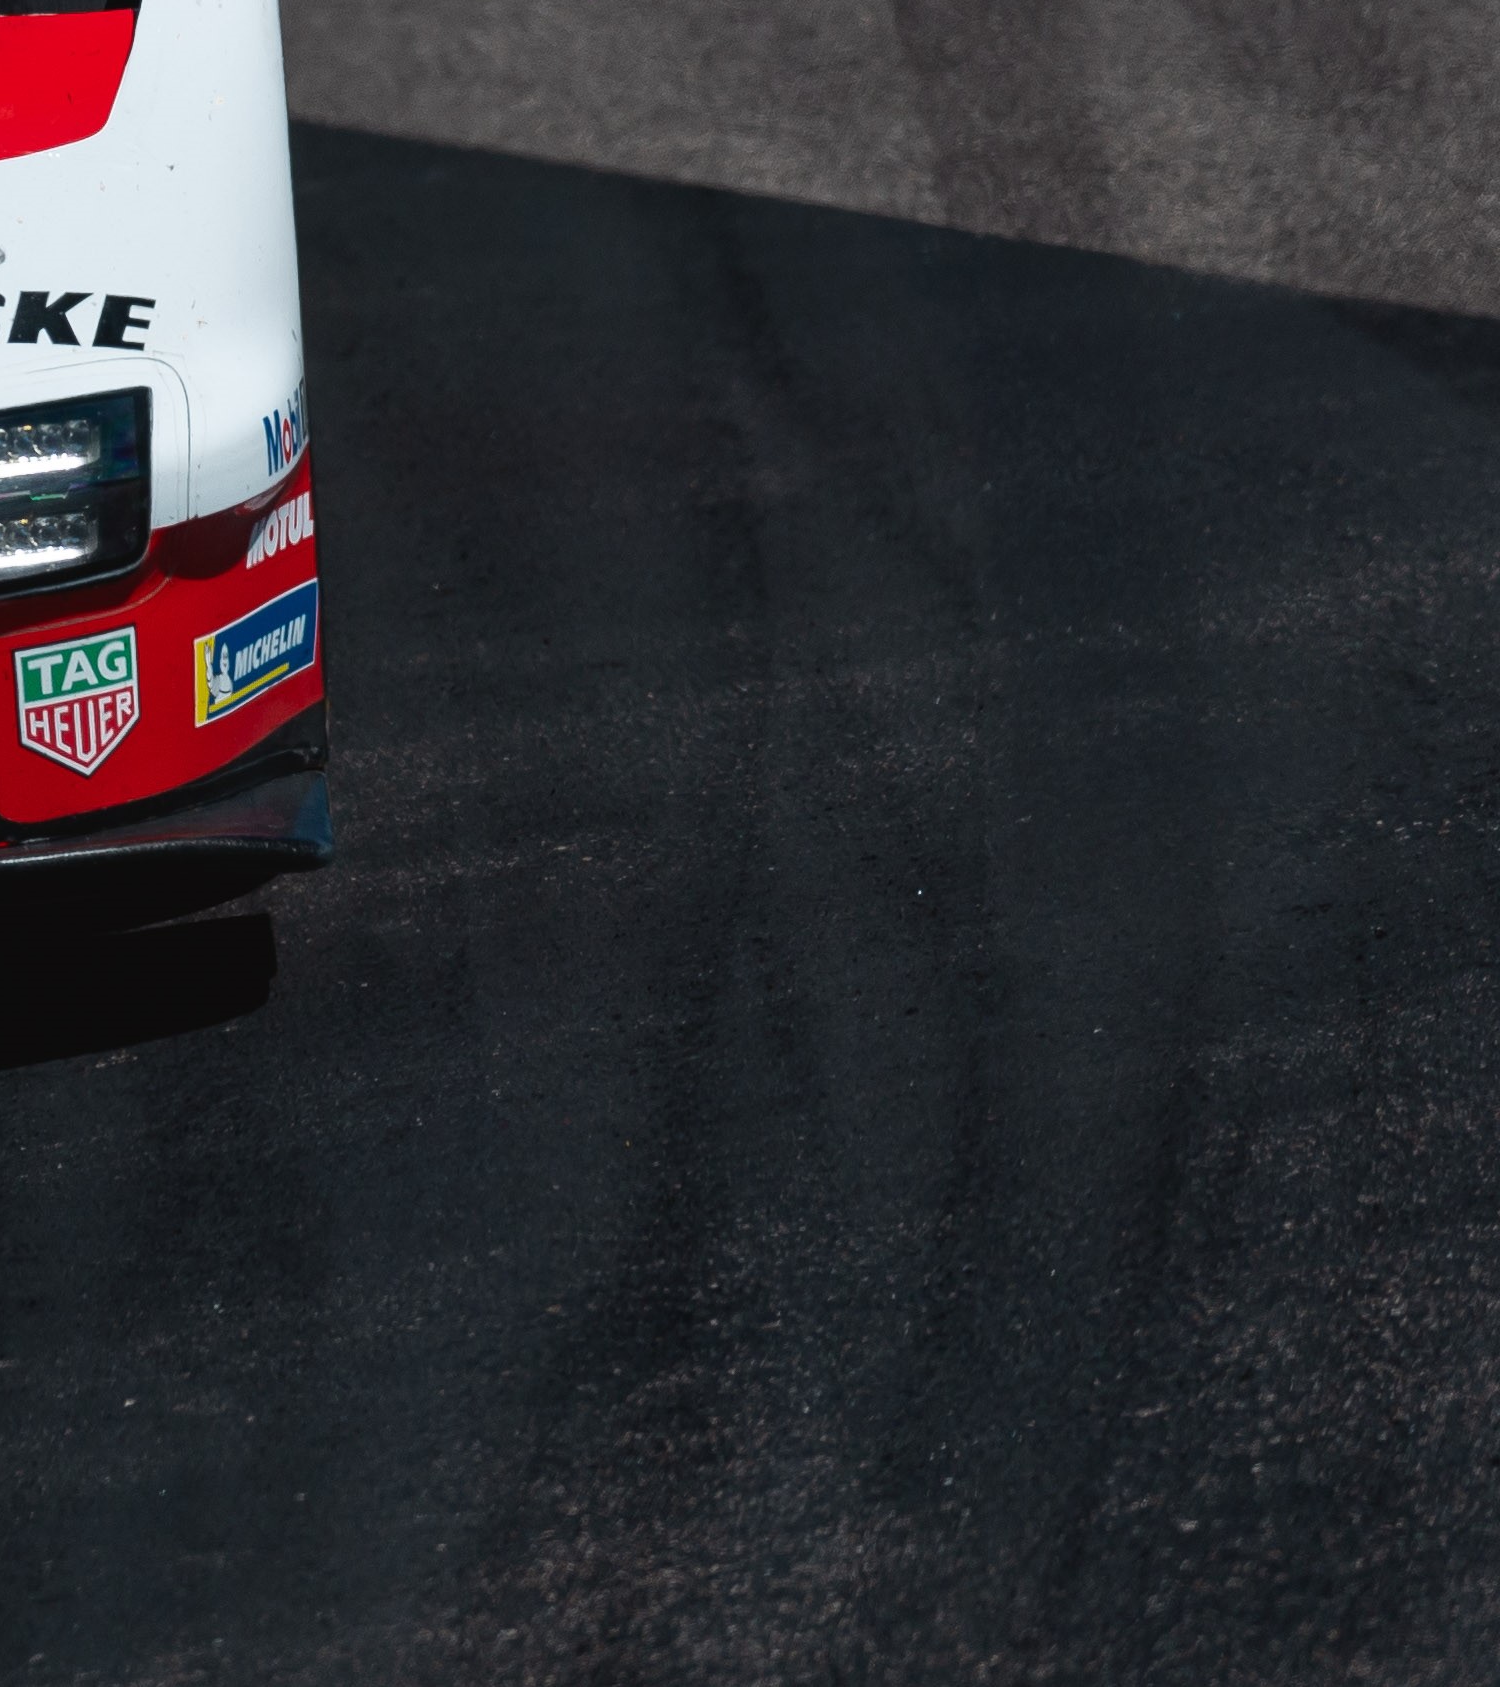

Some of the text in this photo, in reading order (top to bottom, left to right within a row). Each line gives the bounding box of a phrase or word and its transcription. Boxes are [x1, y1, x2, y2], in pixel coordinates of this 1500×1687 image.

[246, 491, 314, 570] MOTUL
[27, 640, 129, 696] TAG
[233, 613, 307, 682] MICHELIN
[29, 693, 133, 764] HEUER
